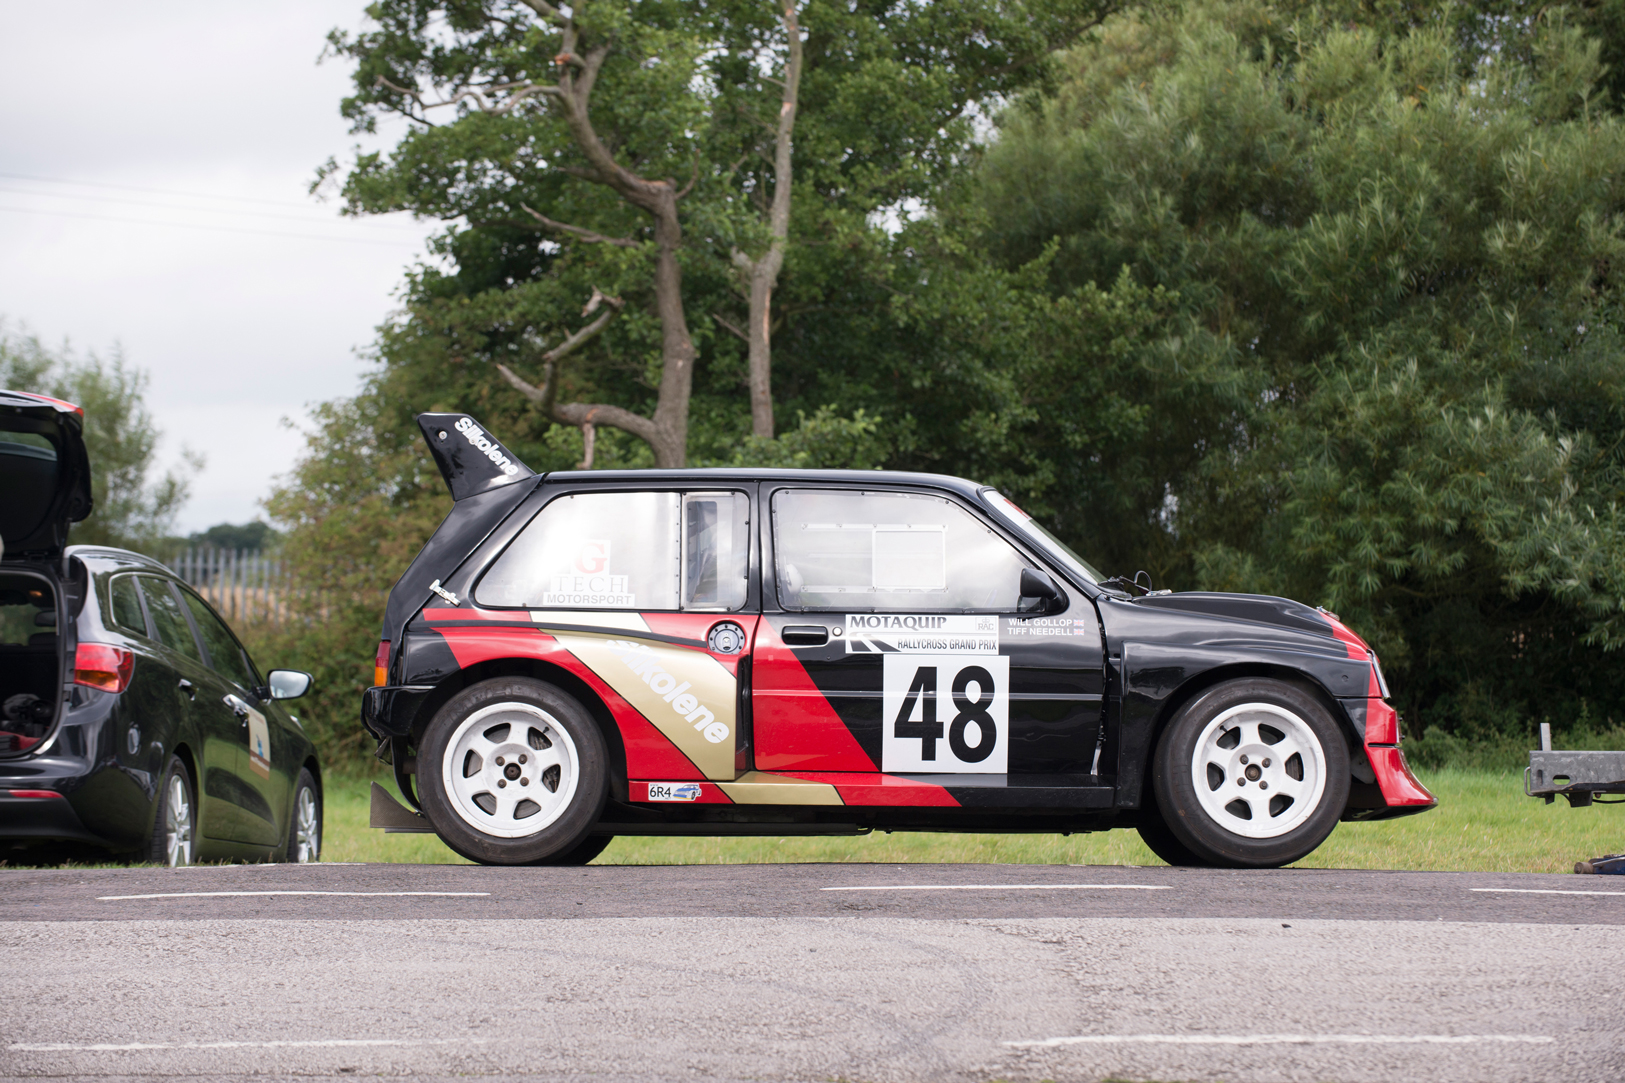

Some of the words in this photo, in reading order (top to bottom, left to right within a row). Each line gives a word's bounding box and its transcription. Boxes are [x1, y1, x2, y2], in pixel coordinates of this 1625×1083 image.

[454, 417, 519, 476] Silkolene
[574, 541, 608, 574] G
[554, 576, 625, 593] TECH
[547, 593, 632, 605] MOTORSPORT
[850, 616, 947, 631] MOTAQUIP
[977, 623, 994, 631] RAC
[1008, 618, 1032, 626] WILL
[1033, 618, 1073, 627] GOLLOP
[1007, 627, 1028, 636] TIFF
[1029, 627, 1073, 636] NEEDELL
[897, 638, 948, 650] RALLYCROSS
[949, 639, 977, 650] GRAND
[978, 639, 997, 651] PRIX
[606, 639, 730, 744] Silkolene
[894, 665, 997, 764] 48
[649, 786, 672, 798] 6R4
